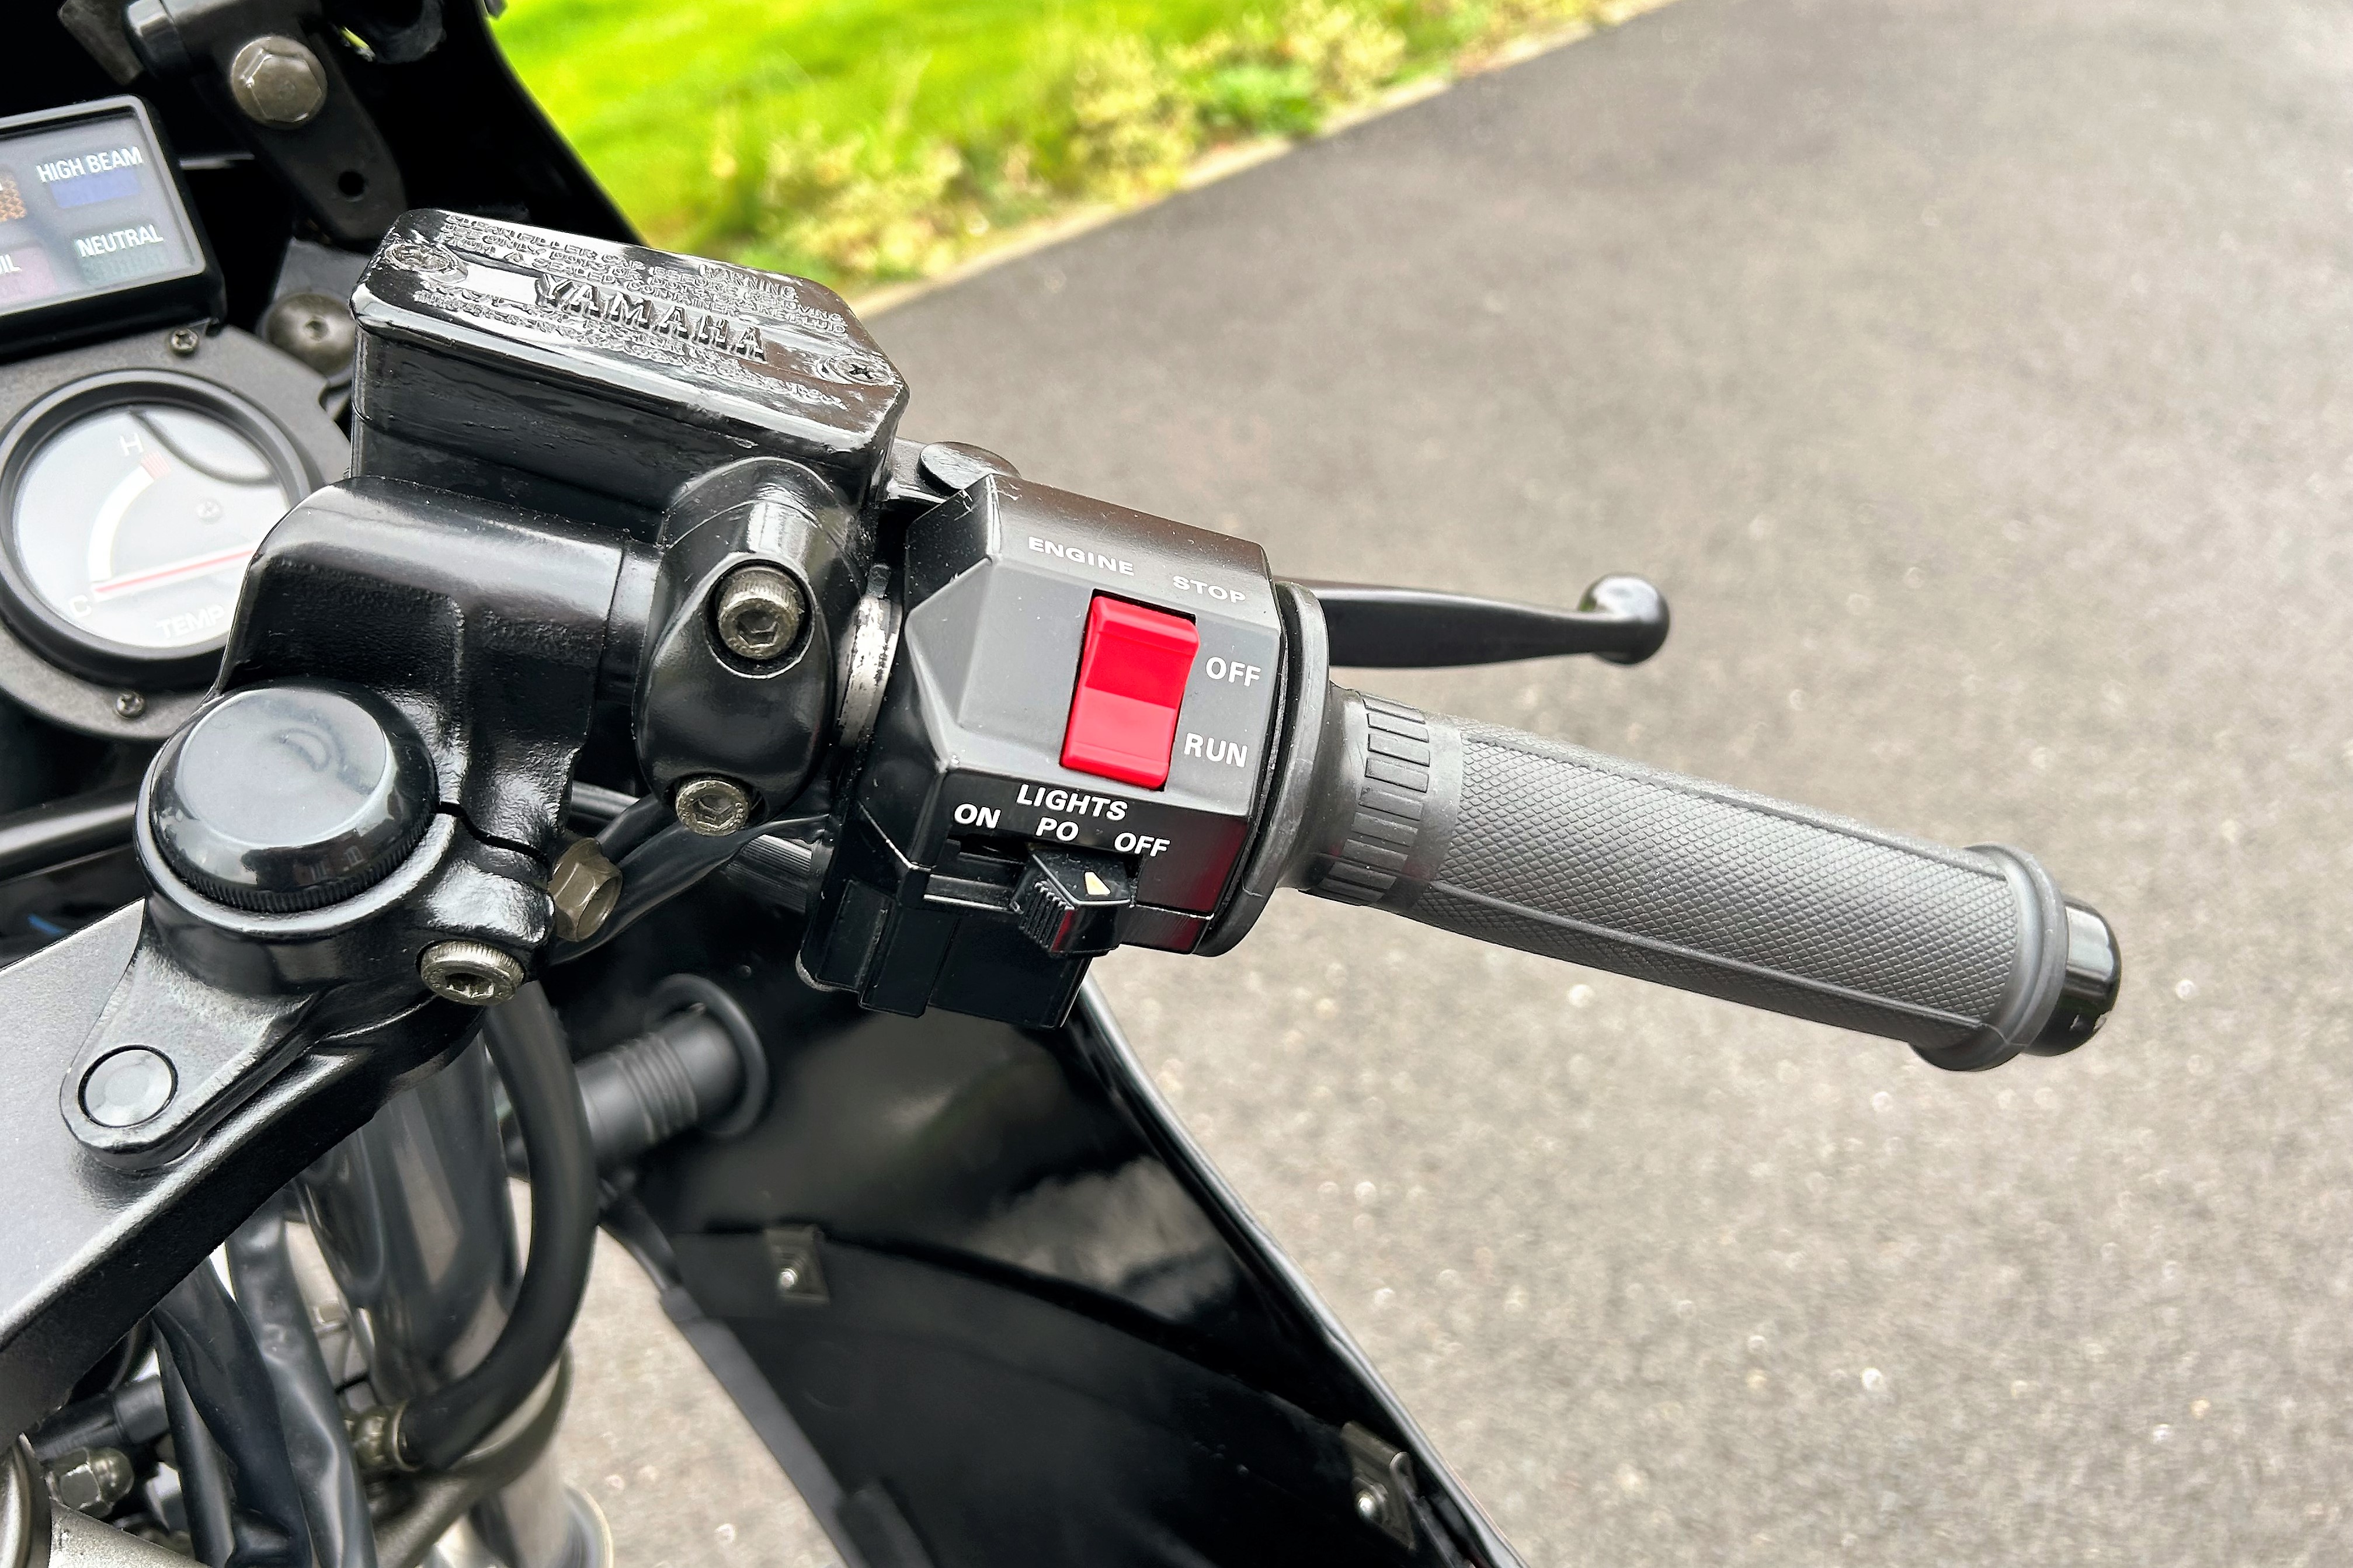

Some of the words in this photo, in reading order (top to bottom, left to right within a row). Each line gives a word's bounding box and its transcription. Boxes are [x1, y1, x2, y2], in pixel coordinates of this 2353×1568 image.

[36, 158, 86, 183] HIGH
[86, 147, 143, 173] BEAM
[75, 224, 164, 257] NEUTRAL
[0, 255, 22, 274] IL
[535, 273, 767, 363] YAMAHA
[120, 432, 144, 456] H
[1028, 536, 1134, 576] ENGINE
[1173, 575, 1246, 604] STOP
[68, 594, 92, 618] C
[155, 604, 225, 638] TEMP
[1205, 656, 1261, 687] OFF
[1184, 733, 1248, 767] RUN
[954, 803, 1001, 828] ON
[1017, 784, 1128, 821] LIGHTS
[1035, 816, 1079, 842] PO
[1114, 832, 1170, 857] OFF
